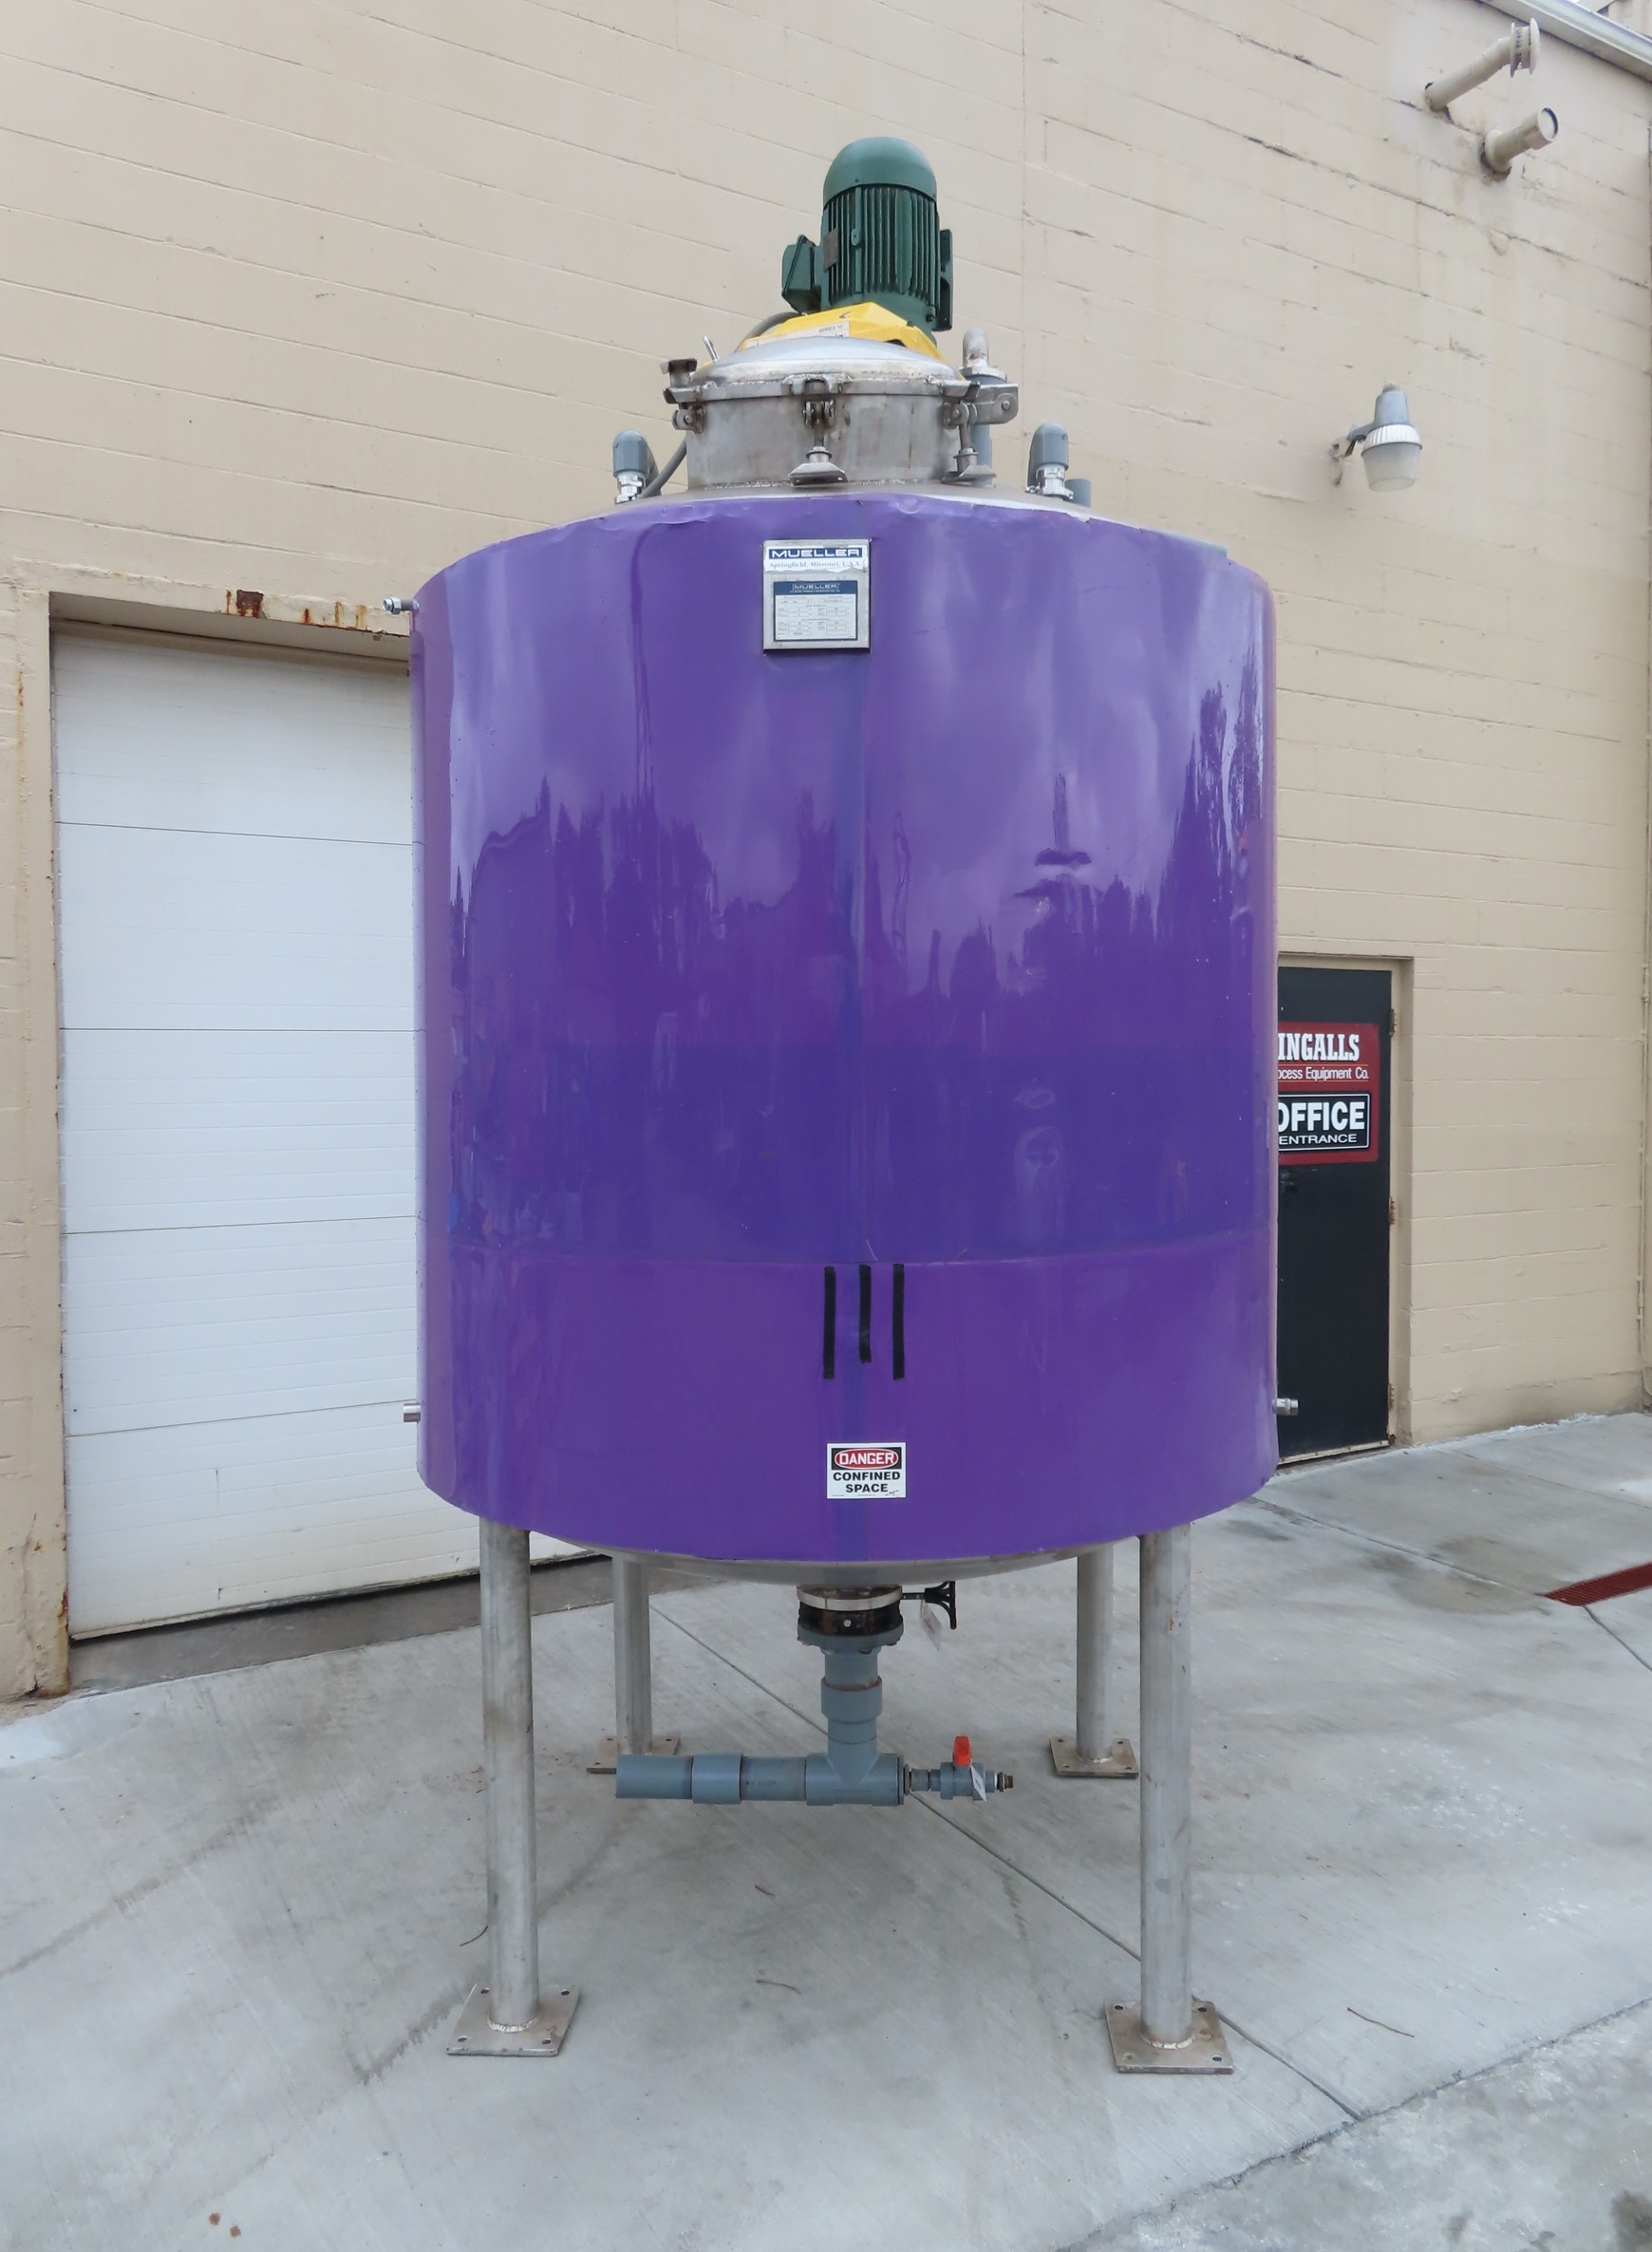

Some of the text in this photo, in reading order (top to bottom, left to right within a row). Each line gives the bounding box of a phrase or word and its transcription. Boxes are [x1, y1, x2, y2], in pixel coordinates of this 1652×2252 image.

[772, 549, 860, 558] MUELLER
[1278, 1033, 1360, 1061] INGALLS
[1278, 1067, 1369, 1081] ocess Equipment Co.
[1278, 1101, 1365, 1133] OFFICE
[1279, 1134, 1358, 1145] ENTRANCE
[839, 1453, 894, 1465] DANGER
[833, 1472, 901, 1481] CONFINED
[845, 1484, 888, 1493] SPACE
